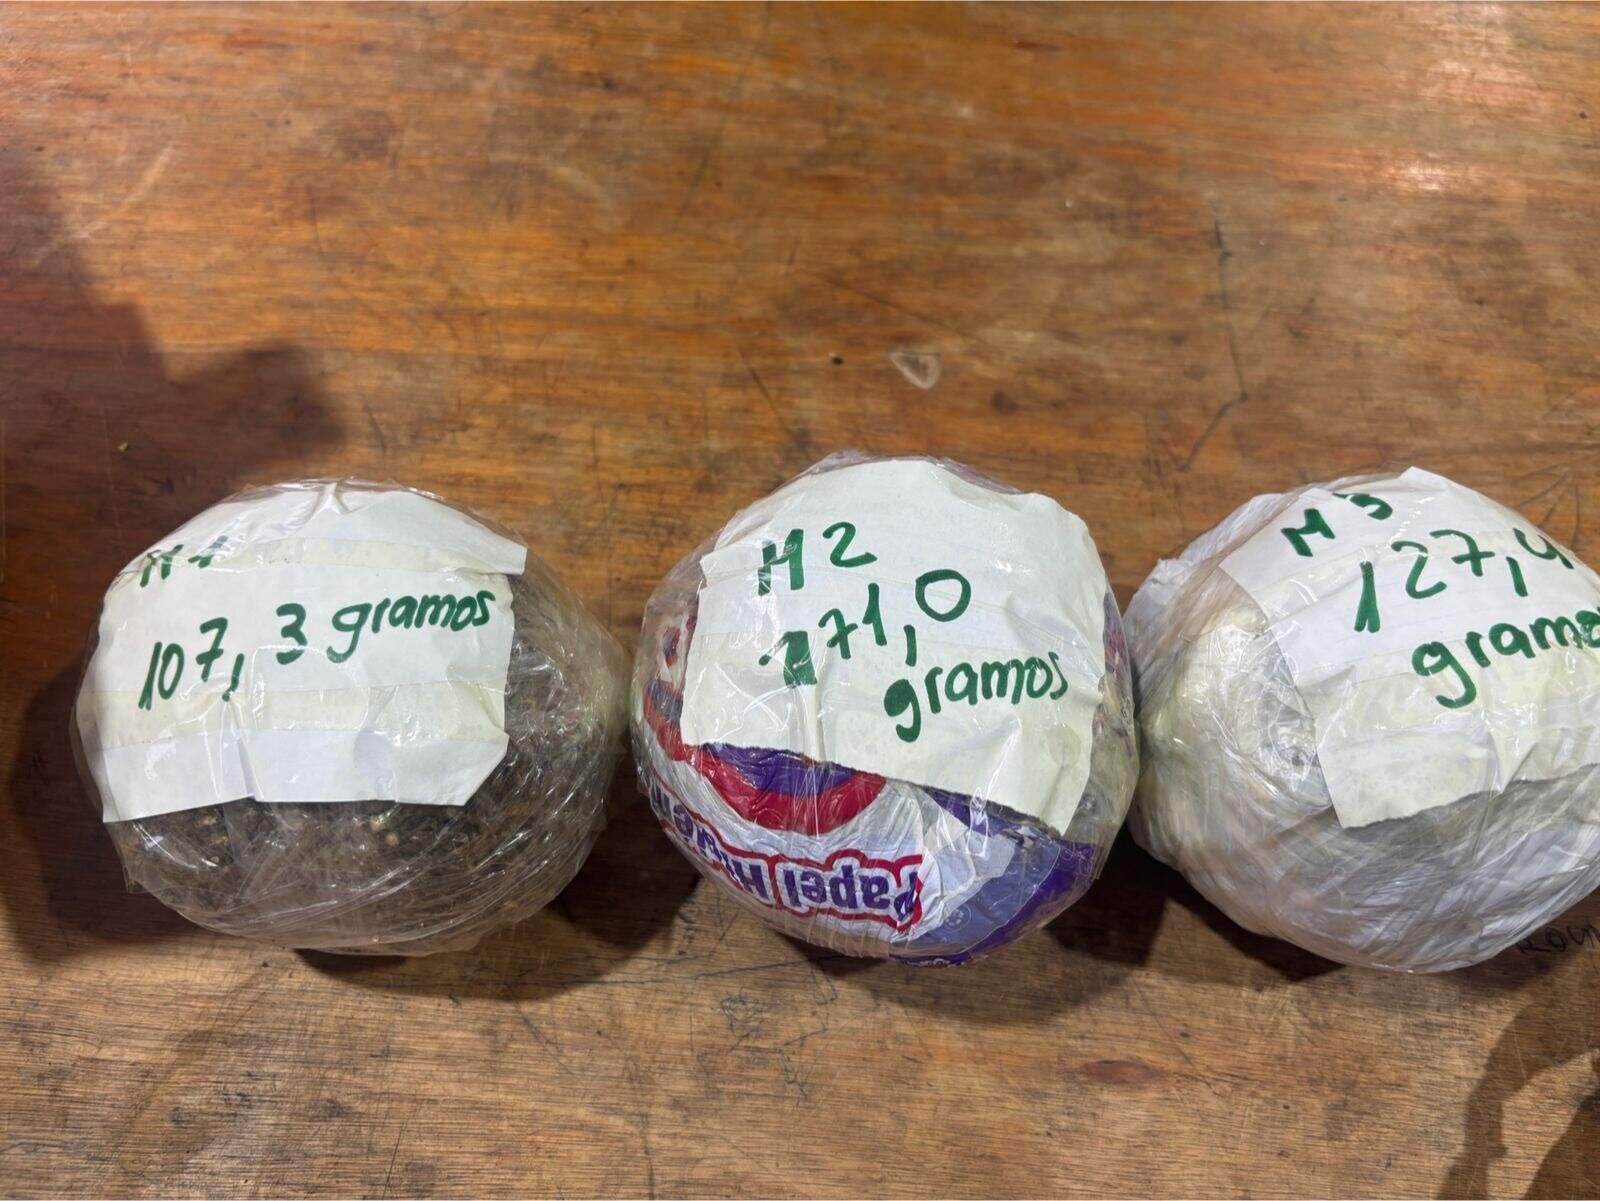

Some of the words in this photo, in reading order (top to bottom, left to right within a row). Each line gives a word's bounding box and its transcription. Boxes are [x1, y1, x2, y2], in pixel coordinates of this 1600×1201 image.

[326, 590, 496, 663] gramos
[1412, 607, 1600, 709] gramo
[883, 651, 1069, 743] gramos
[782, 864, 920, 922] Papel
